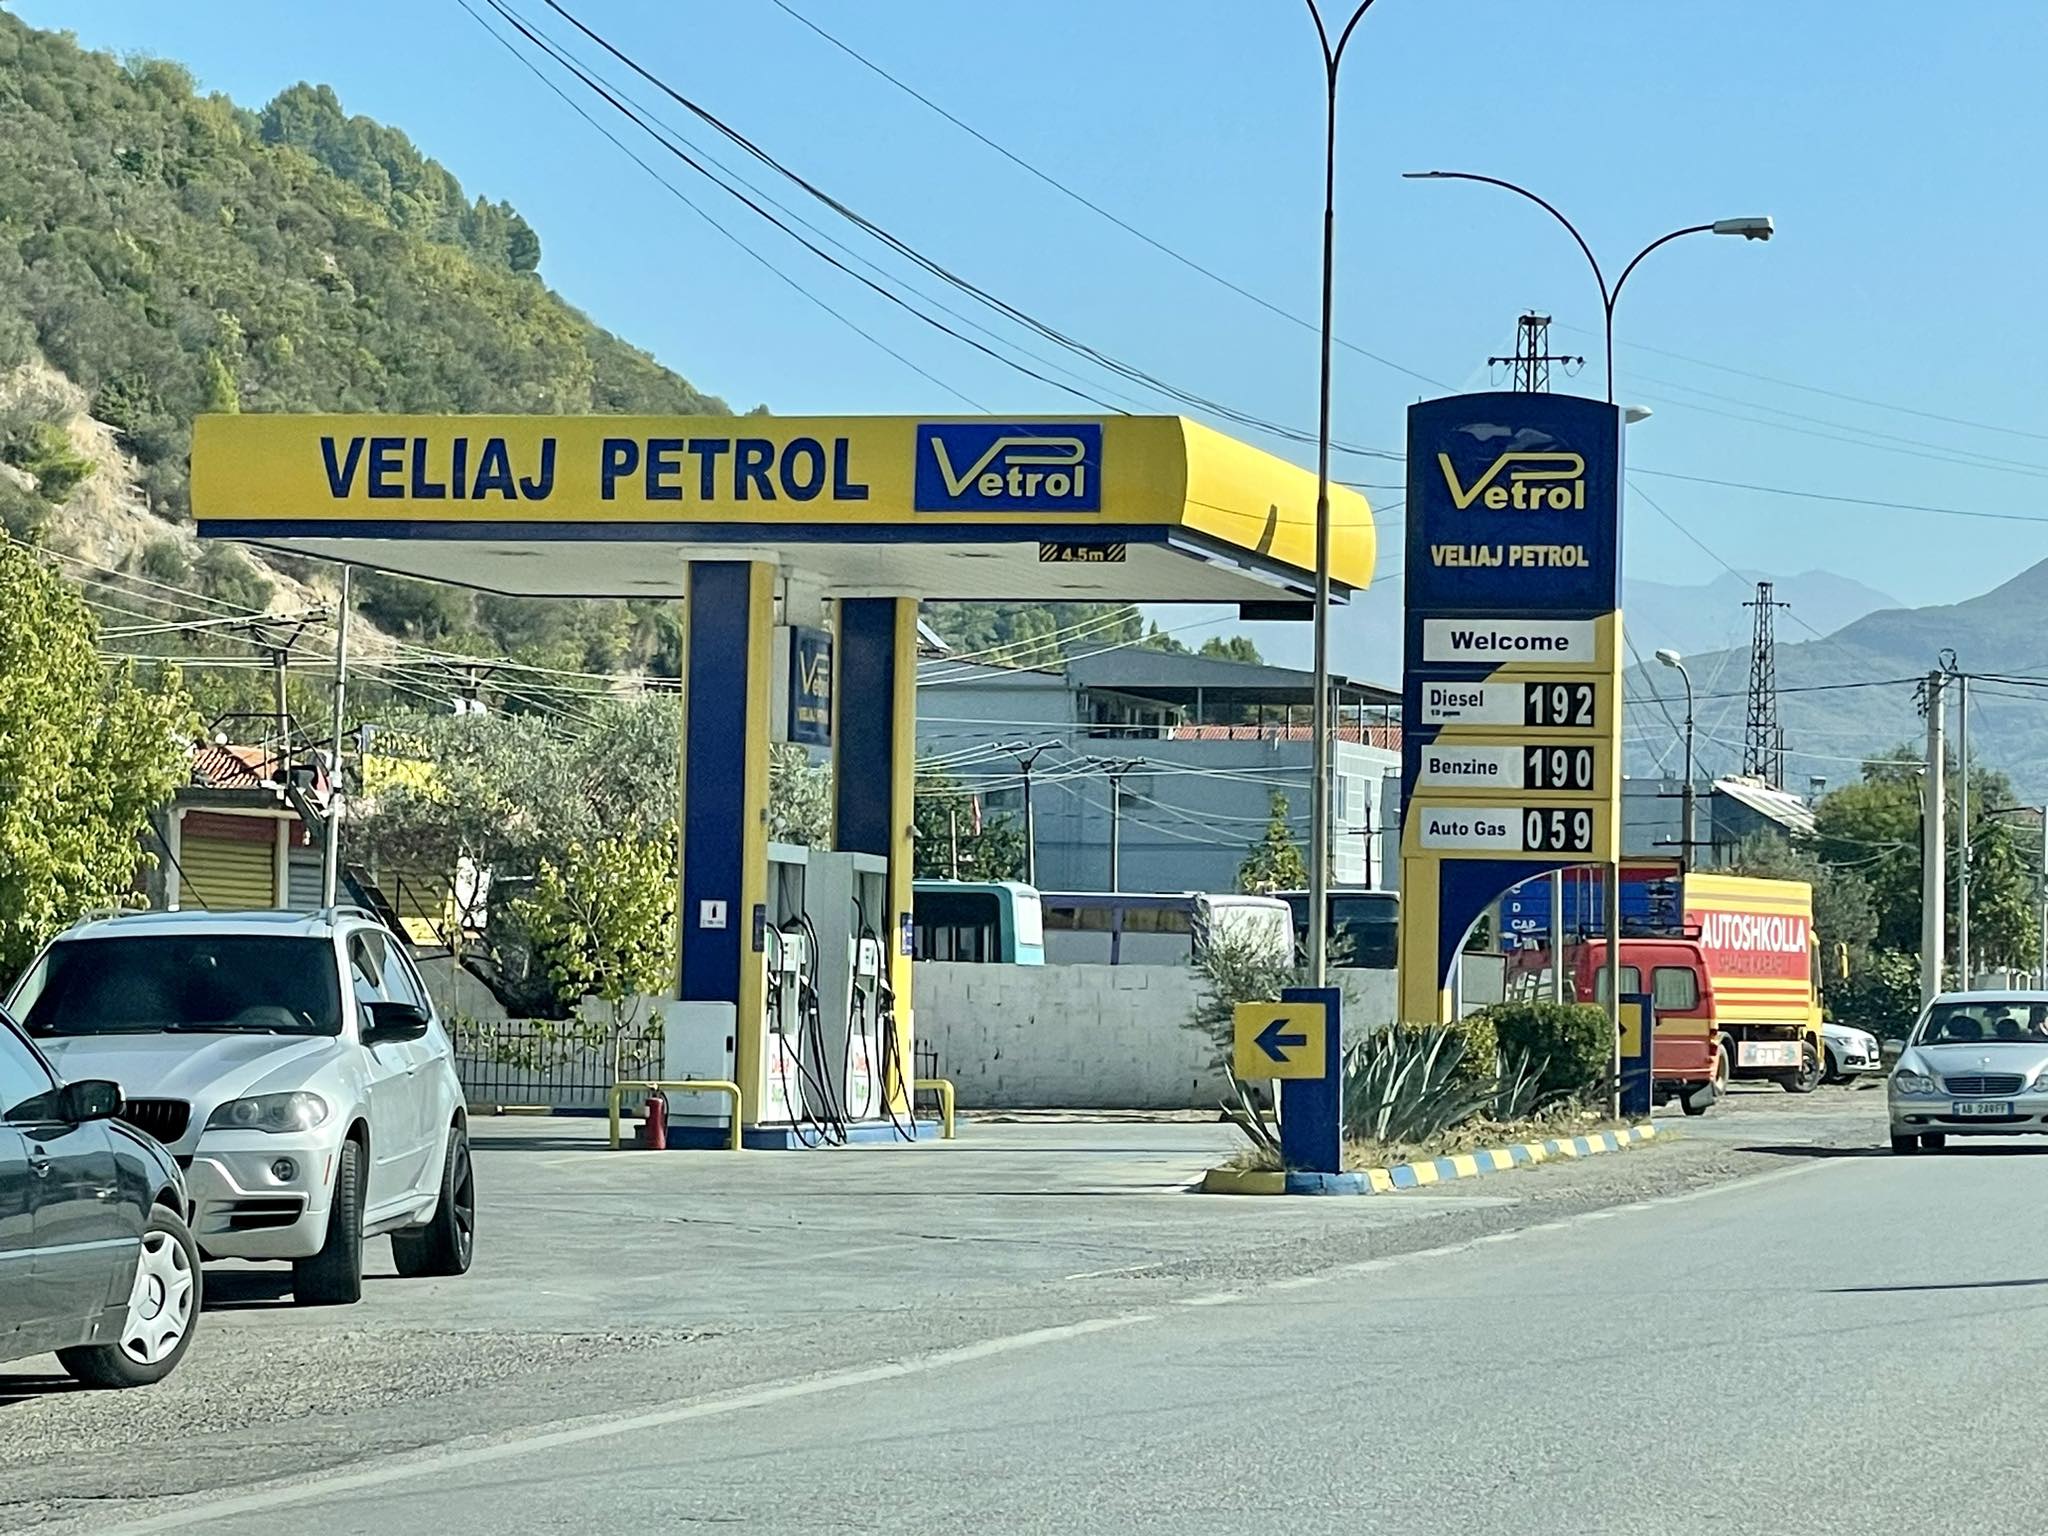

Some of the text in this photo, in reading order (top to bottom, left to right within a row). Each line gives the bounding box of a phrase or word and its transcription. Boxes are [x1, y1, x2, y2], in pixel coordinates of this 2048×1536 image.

[320, 437, 869, 501] VELIAJ PETROL
[1061, 547, 1104, 561] 4.5m
[1430, 544, 1590, 568] VELIAJ PETROL
[1450, 631, 1570, 651] Welcome
[1430, 685, 1593, 724] Diesel 192
[1429, 748, 1592, 788] Benzine 190
[1429, 810, 1591, 850] Auto Gas 059
[1511, 919, 1536, 929] CAP
[1700, 913, 1807, 953] AUTOSHKOLLA
